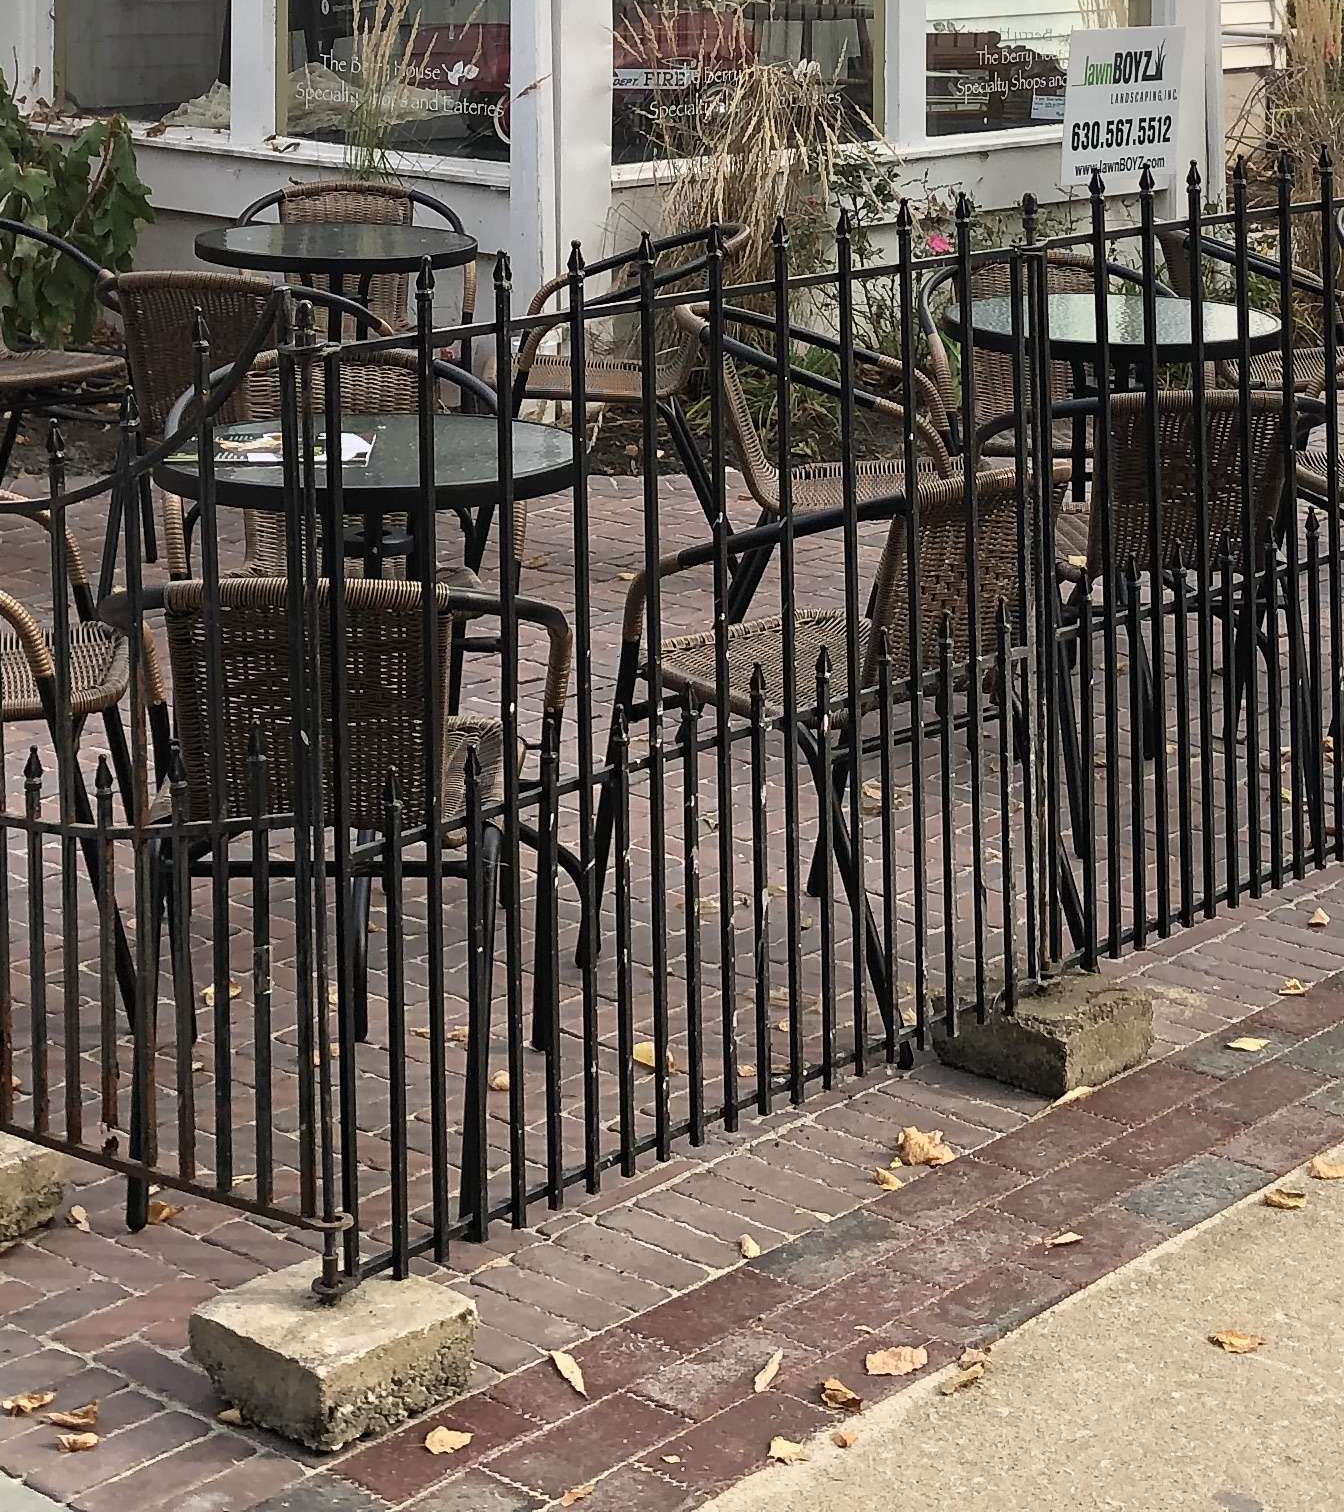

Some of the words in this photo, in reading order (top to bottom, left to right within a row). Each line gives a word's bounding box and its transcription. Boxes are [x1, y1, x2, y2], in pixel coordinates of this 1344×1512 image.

[320, 48, 347, 73] The
[976, 45, 999, 66] The
[1001, 48, 1034, 71] Berry
[643, 71, 686, 87] FIRE
[955, 71, 1009, 105] Specialty
[1011, 69, 1047, 98] Shops
[410, 88, 439, 112] and
[443, 95, 505, 118] Eateries
[1071, 115, 1172, 152] 630.567.5512
[1074, 155, 1165, 177] wwwlawnBOYZcom
